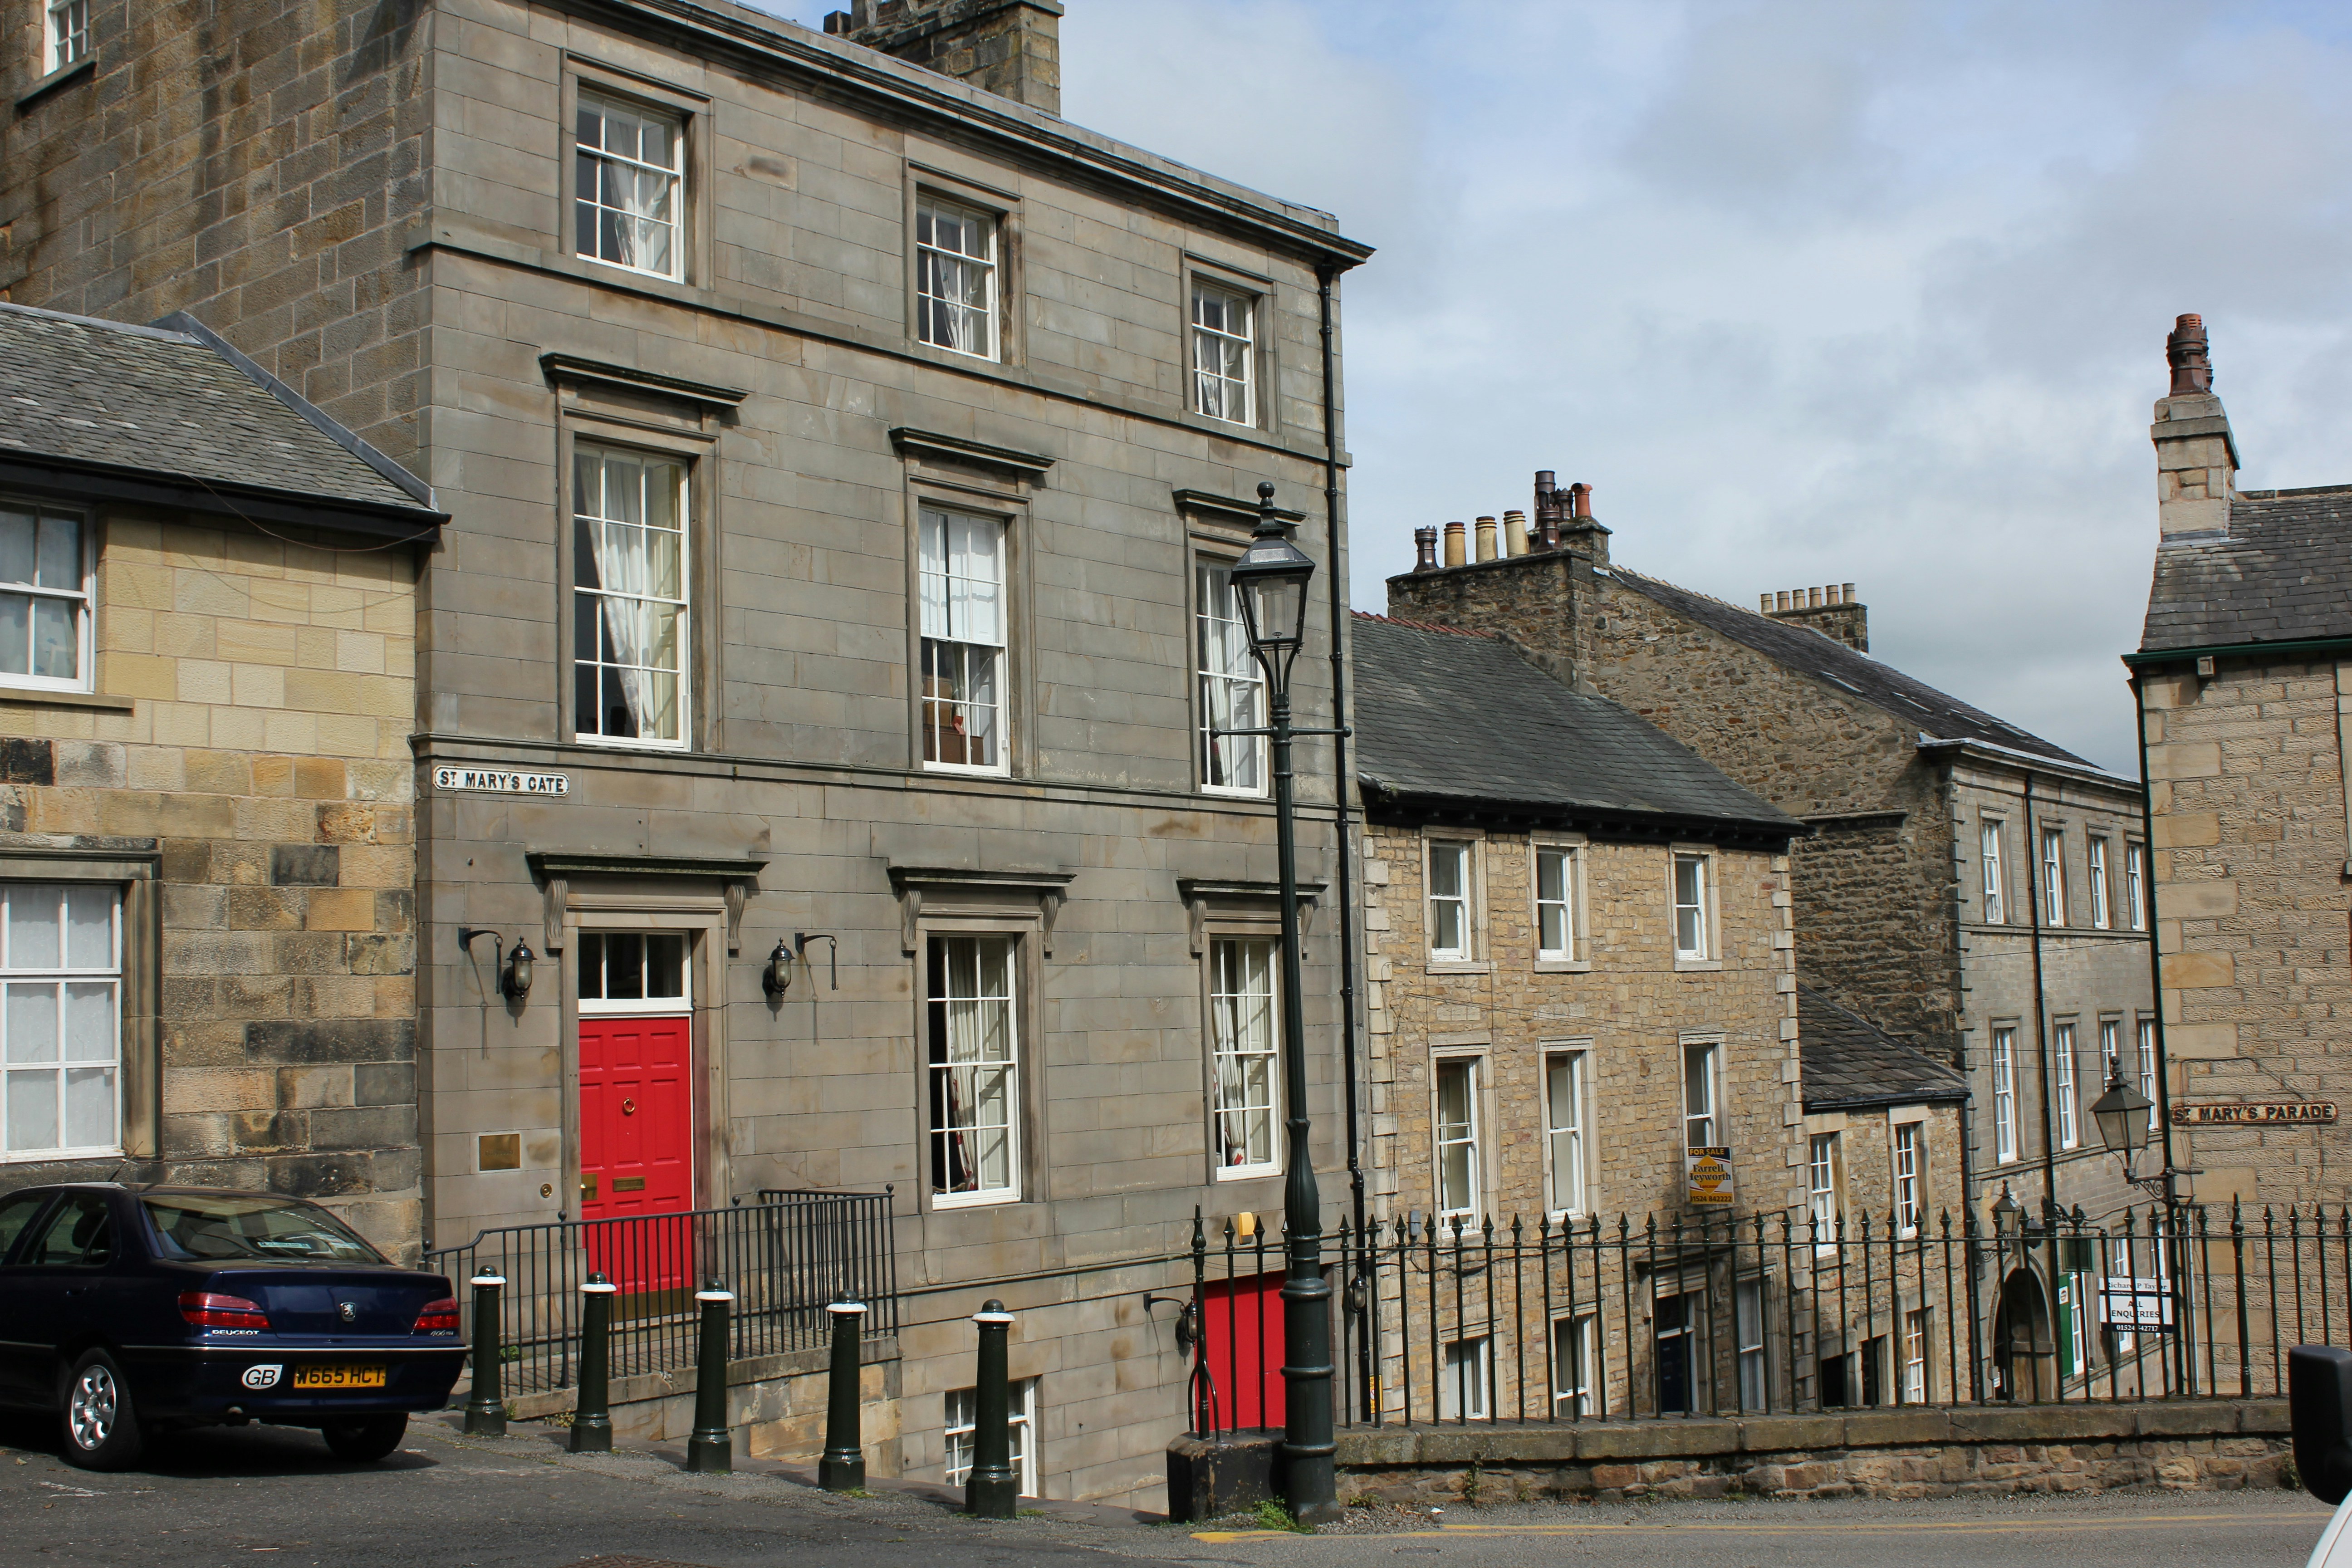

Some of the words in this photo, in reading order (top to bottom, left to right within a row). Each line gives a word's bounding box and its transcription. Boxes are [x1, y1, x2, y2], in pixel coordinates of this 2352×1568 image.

[466, 772, 520, 790] MARY'S
[529, 776, 564, 792] GATE
[2199, 1106, 2258, 1121] MARY'S
[2266, 1105, 2332, 1120] PARADE
[1693, 1164, 1724, 1172] Farrell
[246, 1369, 276, 1385] GB
[297, 1367, 345, 1384] W665
[350, 1367, 384, 1383] HCT
